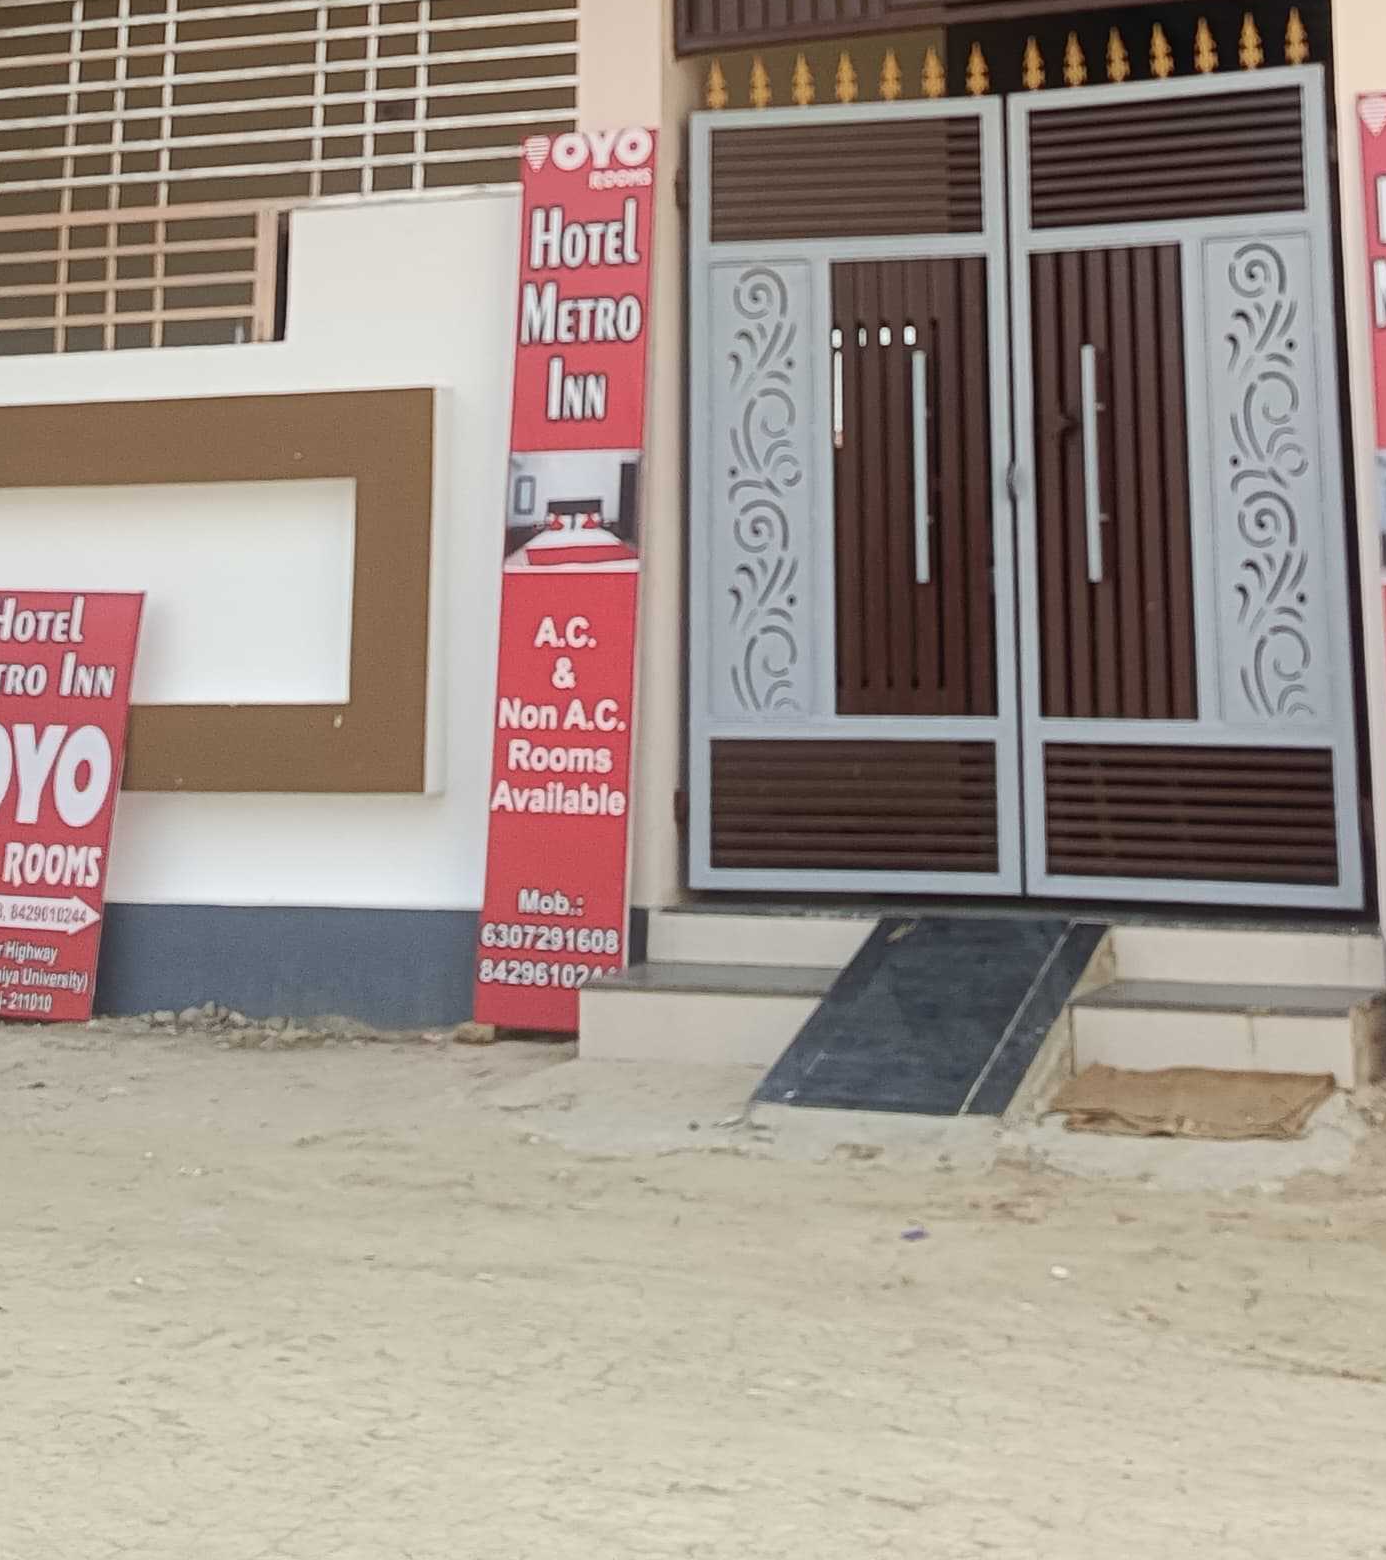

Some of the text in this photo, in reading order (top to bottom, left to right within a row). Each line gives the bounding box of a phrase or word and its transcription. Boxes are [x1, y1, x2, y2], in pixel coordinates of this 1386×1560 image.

[551, 127, 653, 171] OYO
[588, 167, 653, 190] ROOMS
[520, 281, 642, 345] METRO
[546, 356, 608, 420] INN
[534, 616, 597, 648] A.C.
[59, 651, 116, 698] INN
[551, 656, 576, 689] &
[498, 697, 626, 731] Non A.C.
[508, 738, 613, 774] Rooms
[490, 779, 626, 816] Available
[2, 842, 103, 888] ROOMS
[10, 904, 87, 924] 8429610244
[518, 889, 584, 916] Mob.:
[4, 940, 59, 966] Highway
[481, 923, 619, 954] 6307291608
[22, 966, 89, 992] University)
[479, 958, 616, 989] 842961024
[8, 992, 52, 1013] 211010
